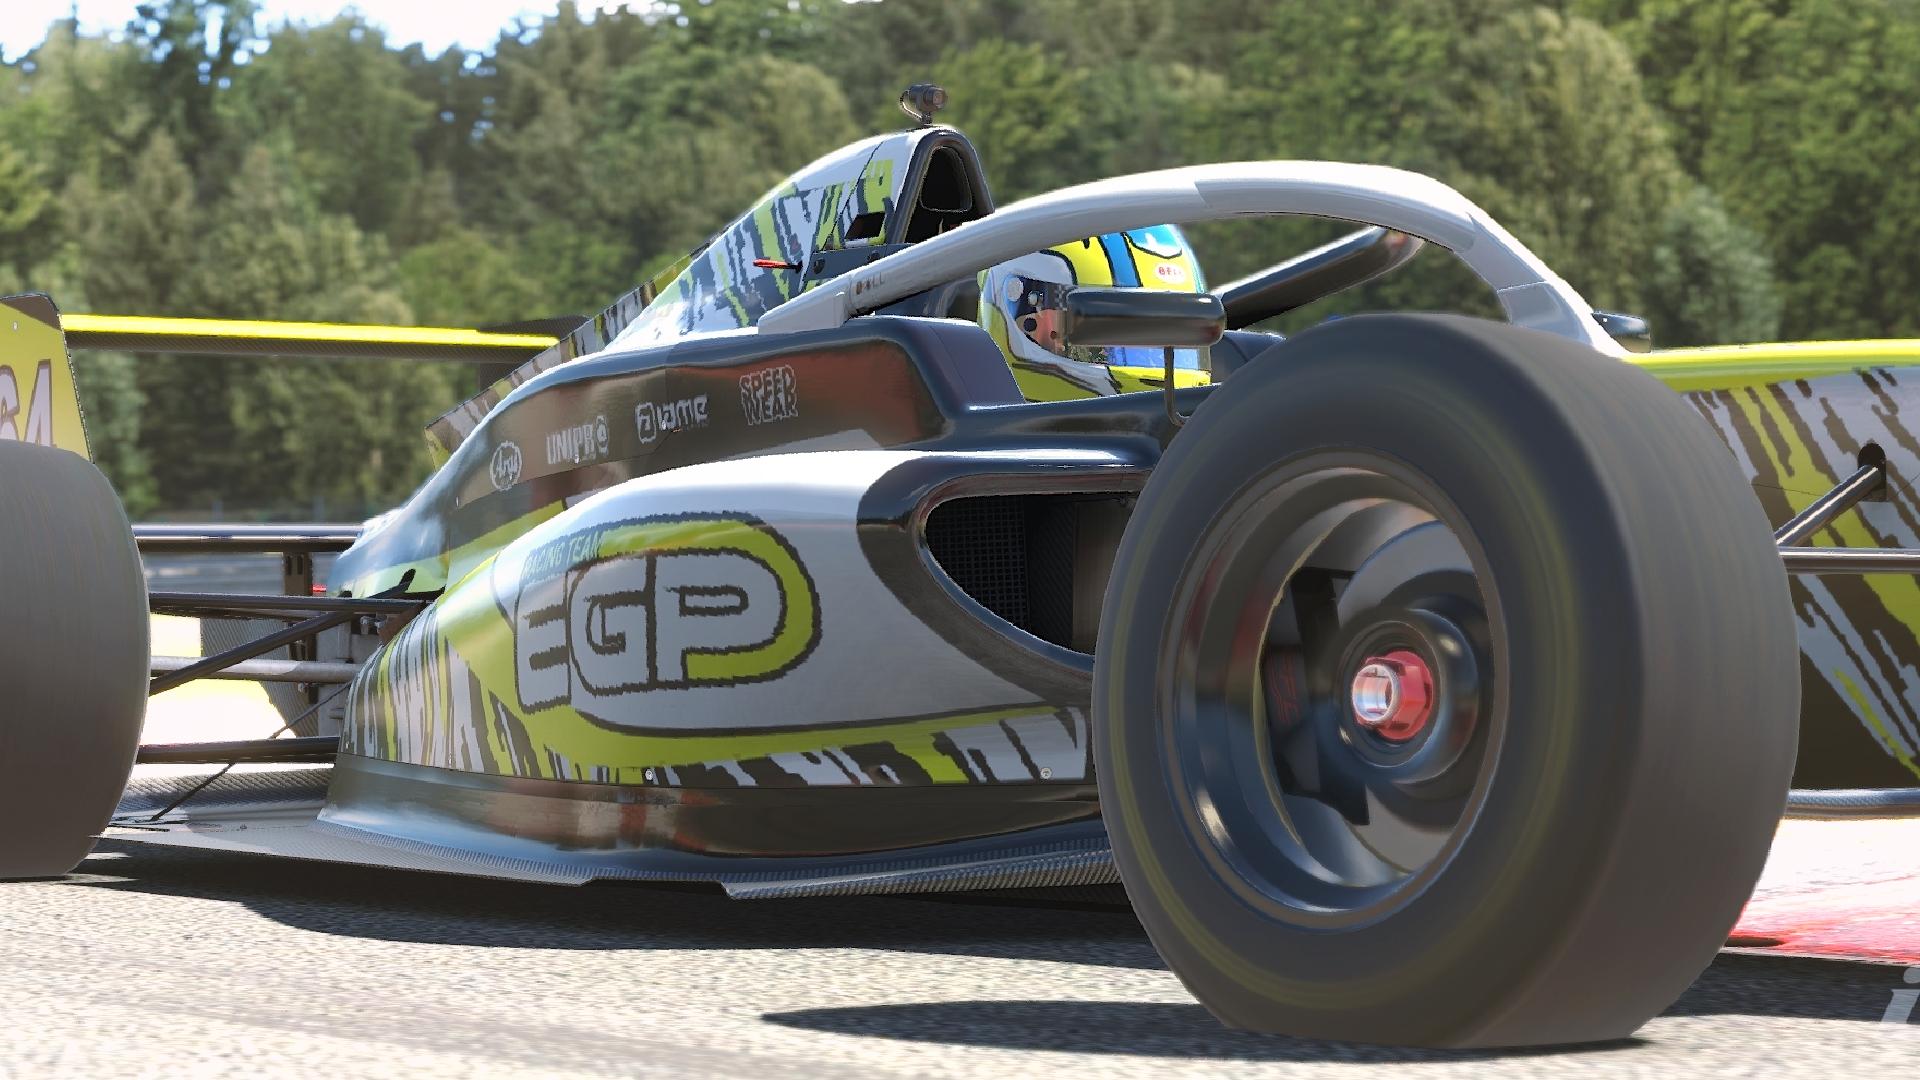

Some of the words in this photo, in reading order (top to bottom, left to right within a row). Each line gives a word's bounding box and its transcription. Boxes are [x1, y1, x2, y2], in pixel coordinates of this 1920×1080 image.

[739, 364, 797, 398] SPEED
[741, 388, 799, 425] WEAR
[514, 546, 787, 714] EGP
